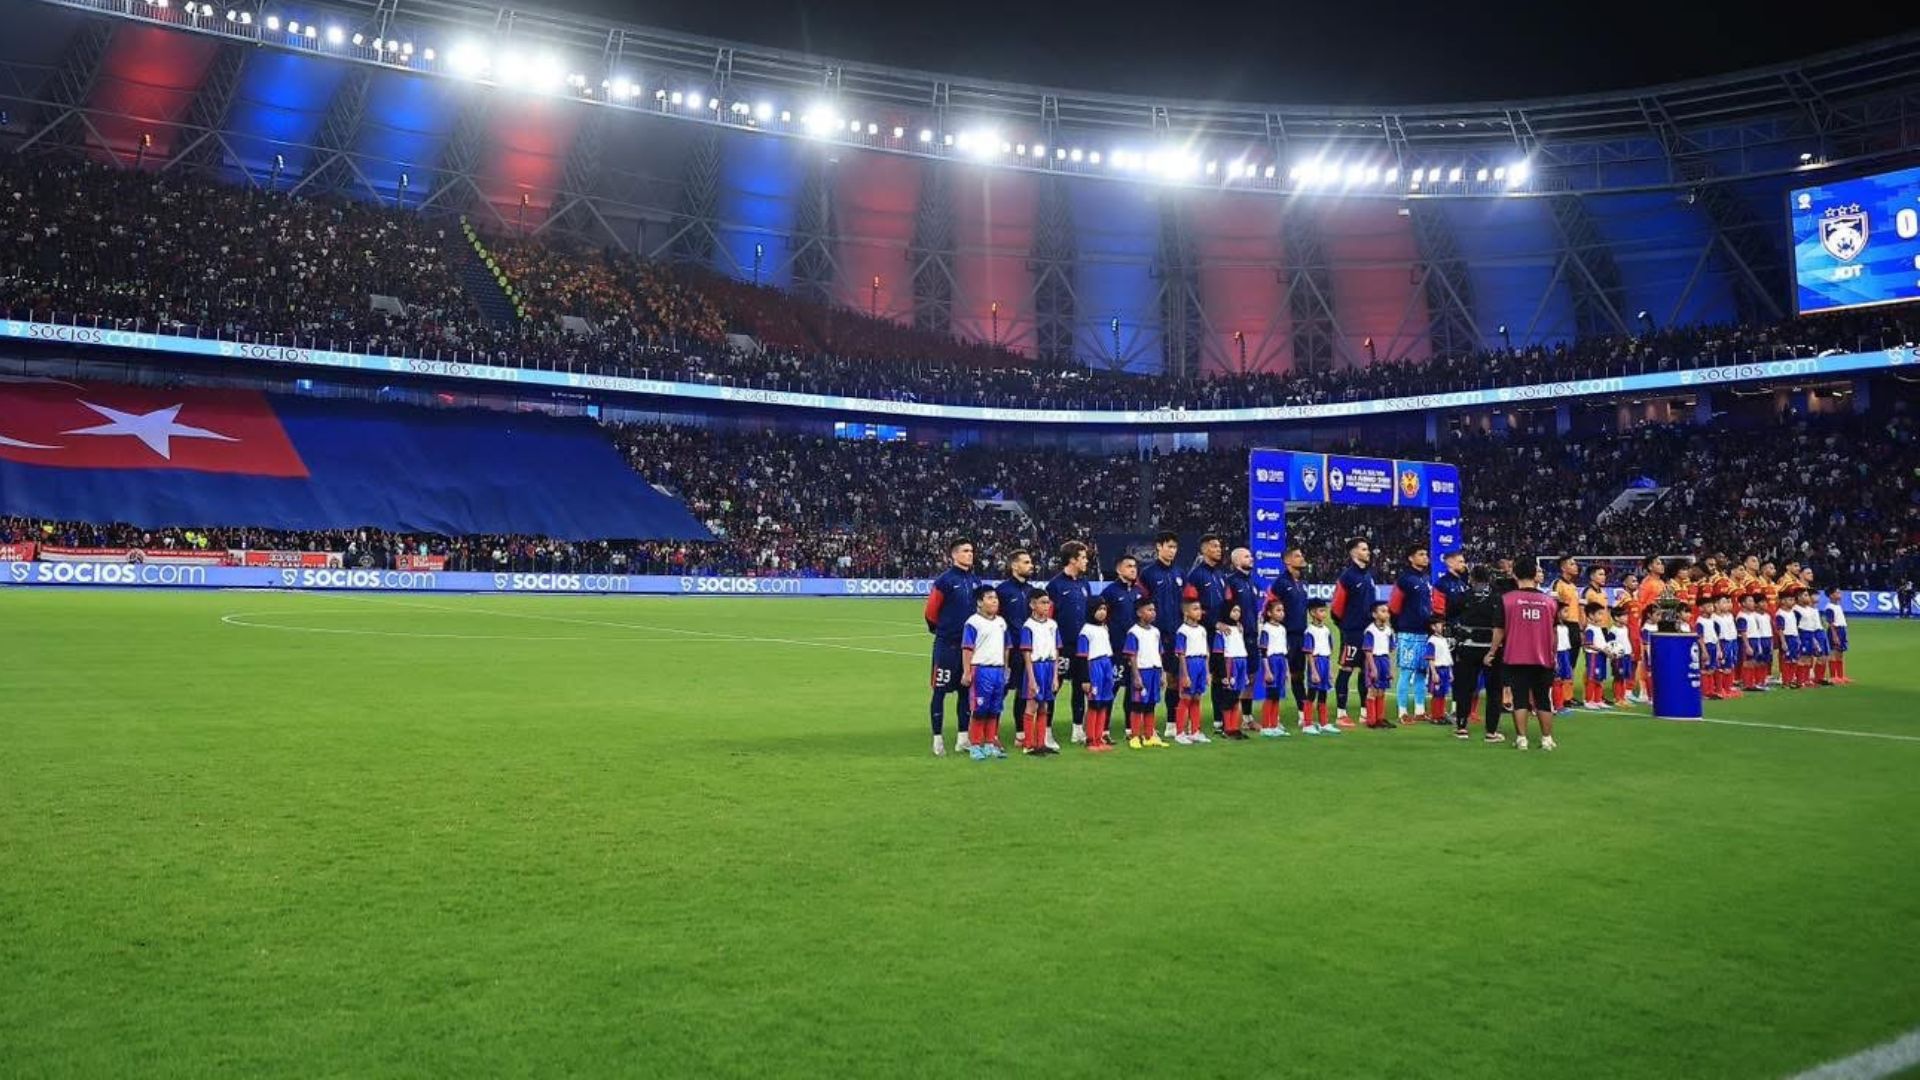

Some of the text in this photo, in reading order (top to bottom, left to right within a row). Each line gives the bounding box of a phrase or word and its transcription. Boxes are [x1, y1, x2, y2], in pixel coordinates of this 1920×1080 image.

[1896, 208, 1918, 239] 0
[37, 562, 206, 584] SOCIOS.com
[303, 570, 436, 588] SOCIOS.com
[512, 573, 630, 591] SOCIOS.com
[697, 577, 801, 593] SOCIOS.com
[860, 579, 935, 594] SOCIOS.c
[1522, 608, 1540, 620] HB
[1346, 645, 1358, 658] 17
[936, 668, 951, 684] 33
